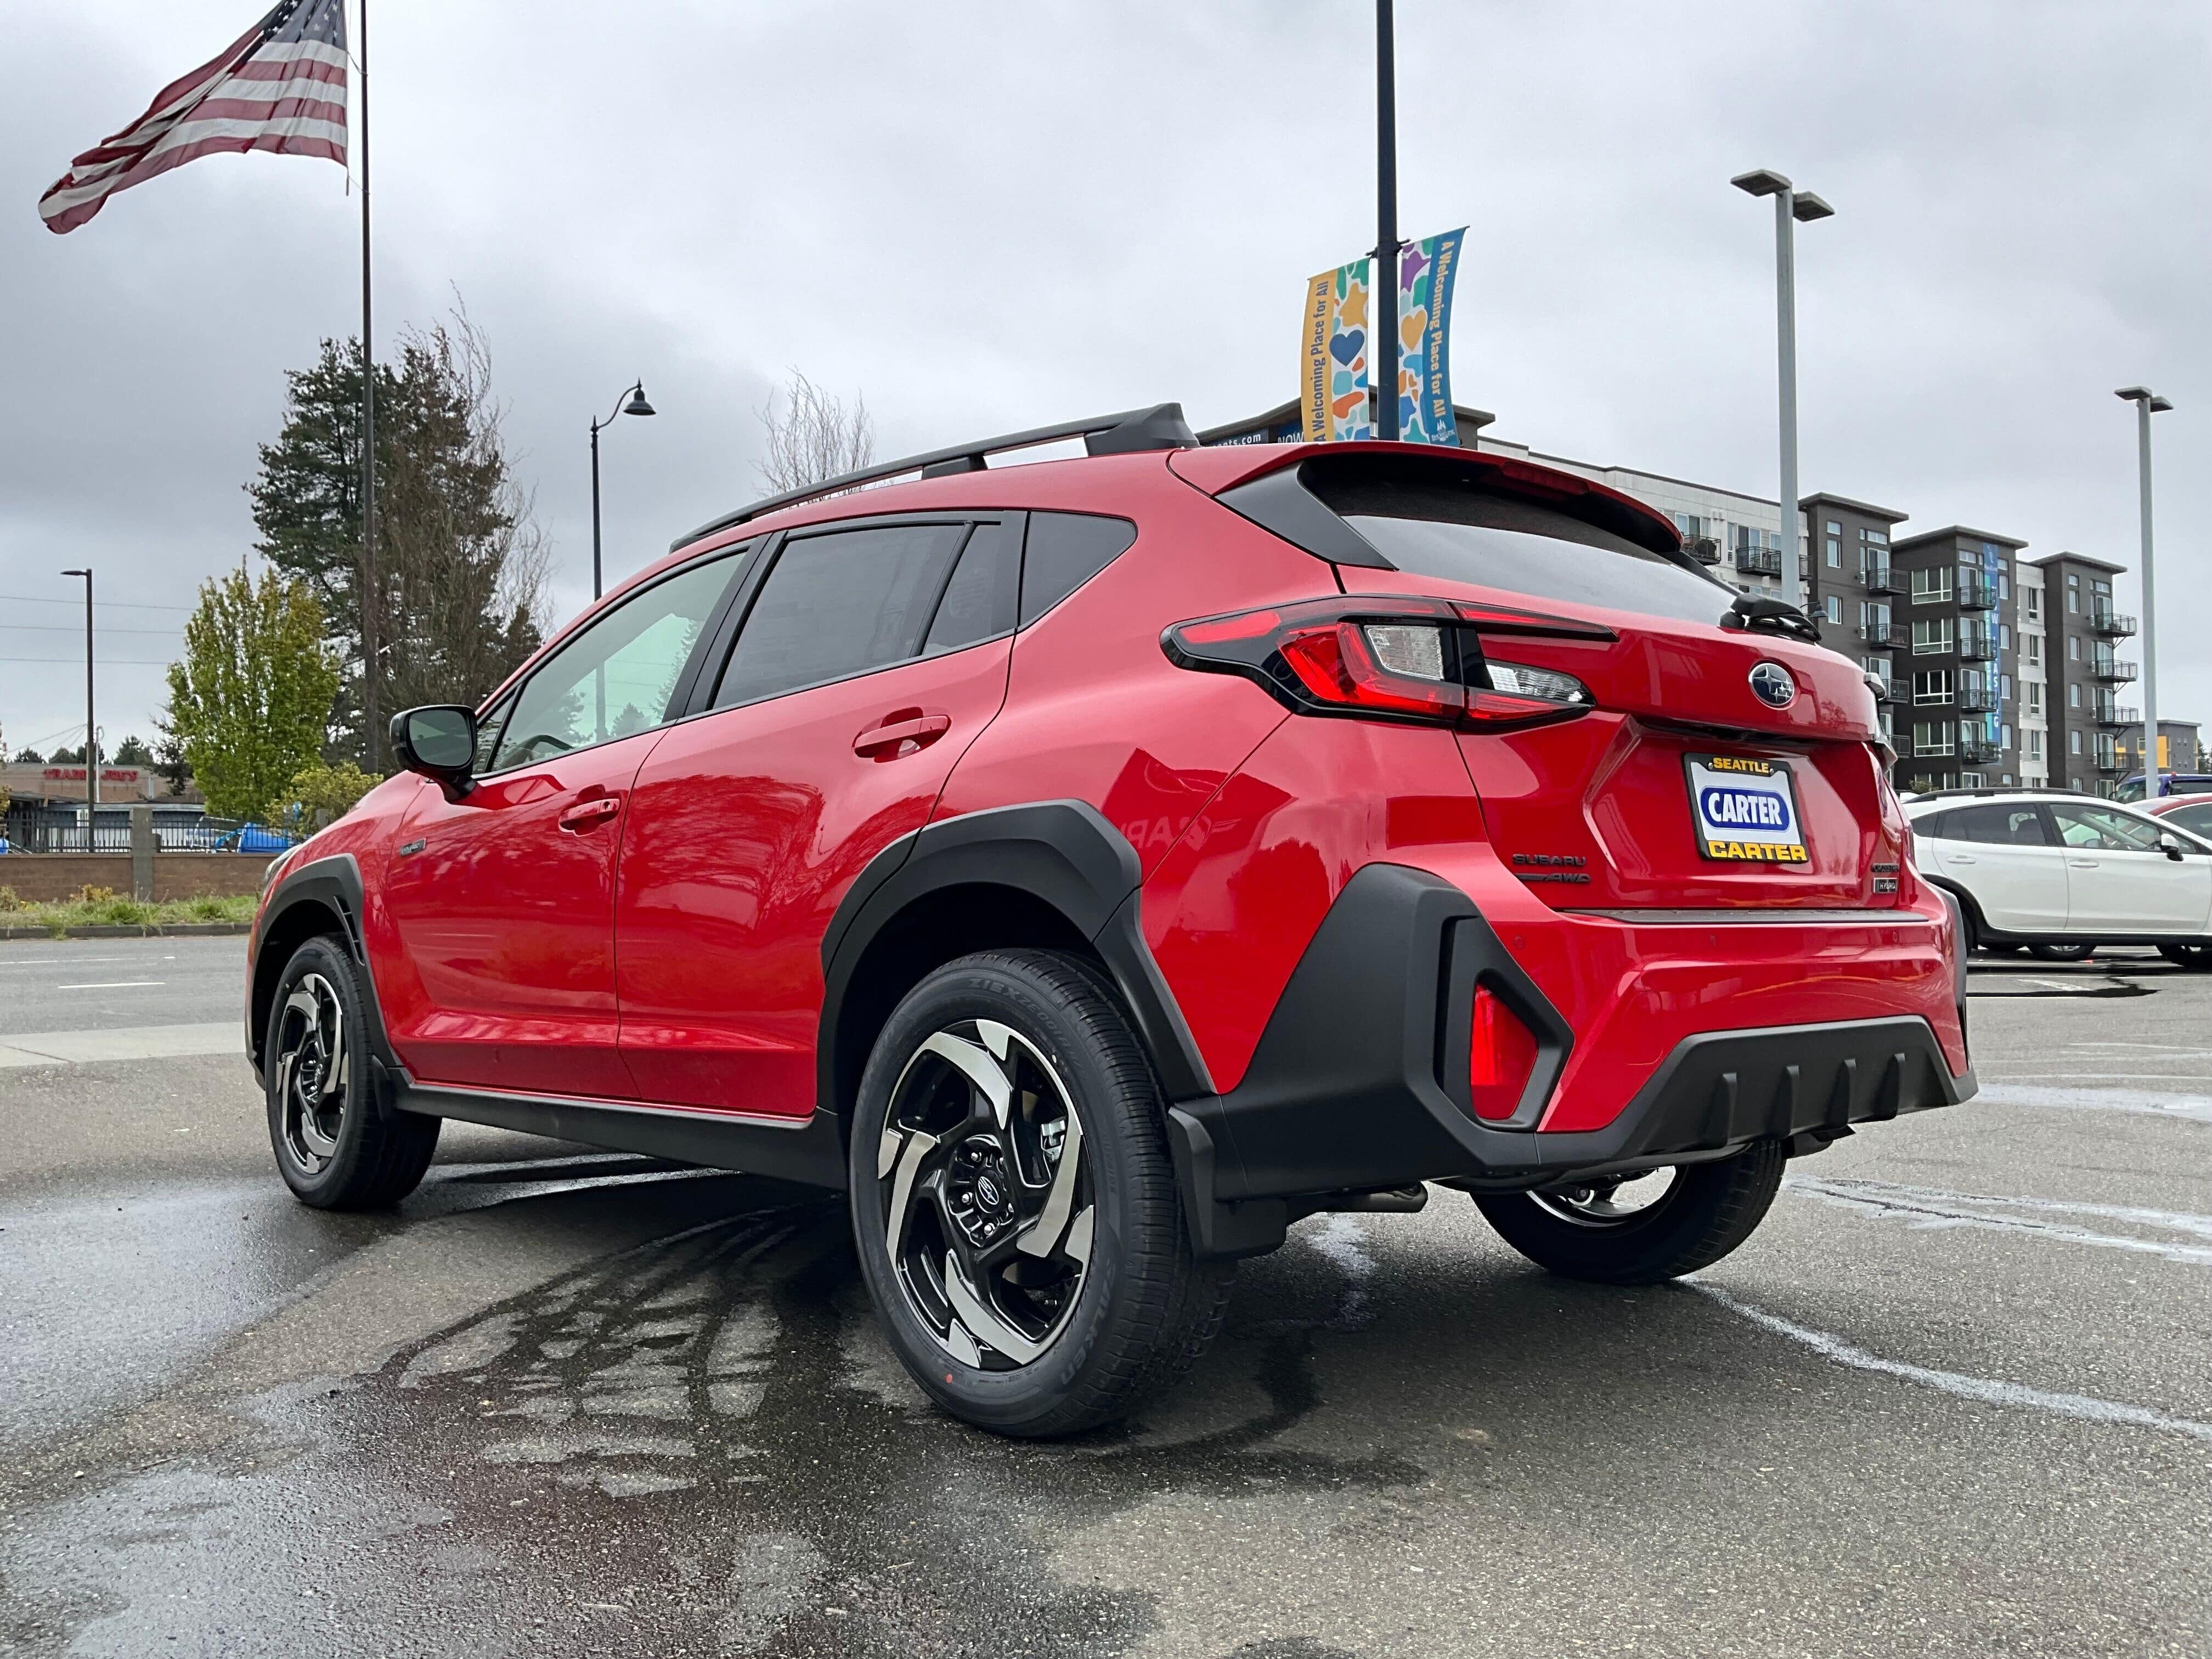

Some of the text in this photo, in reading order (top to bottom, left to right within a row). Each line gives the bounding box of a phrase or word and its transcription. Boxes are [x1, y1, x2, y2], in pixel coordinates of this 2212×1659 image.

[1429, 241, 1454, 417] A Welcoming Place for All
[1310, 280, 1329, 442] A Welcoming Place for All
[1277, 432, 1304, 444] NOW
[1713, 757, 1769, 774] SEATTLE
[1708, 792, 1782, 825] CARTER
[1513, 853, 1587, 866] SUBARU
[1708, 840, 1807, 861] CARTER
[1545, 872, 1592, 883] AWD
[969, 978, 1020, 1001] ZIEX
